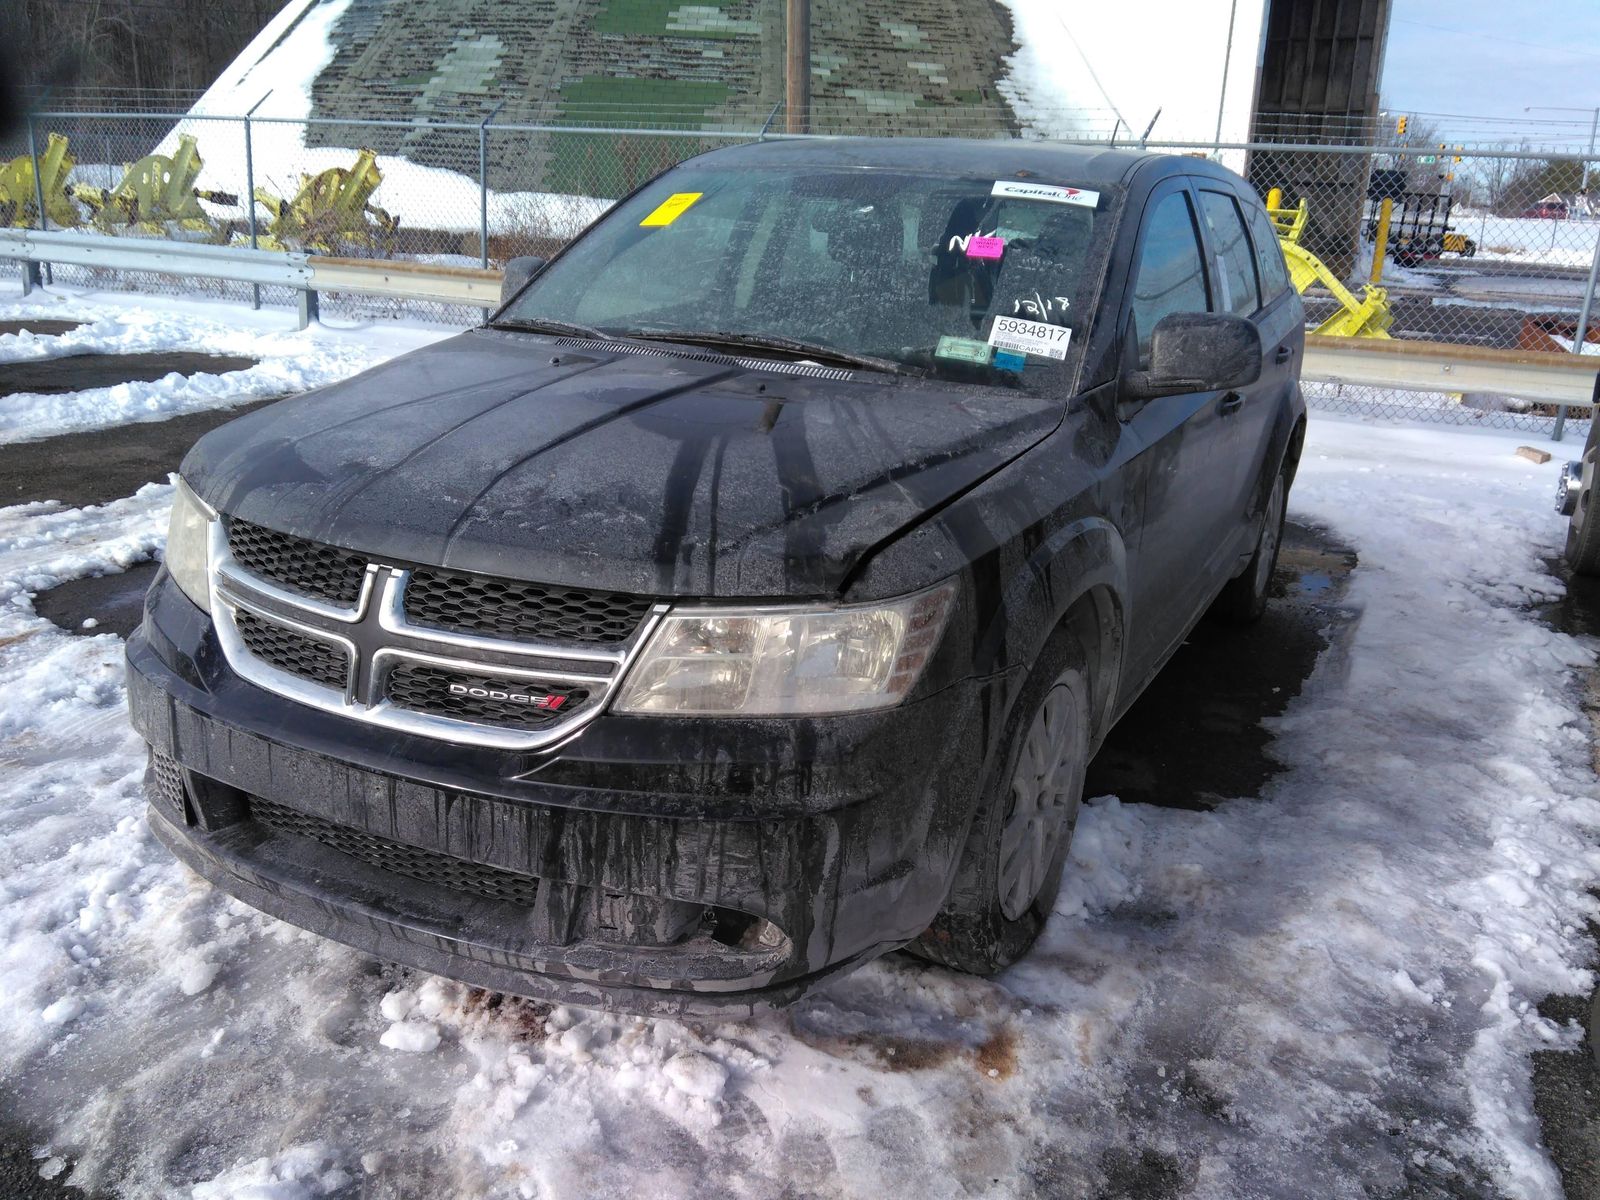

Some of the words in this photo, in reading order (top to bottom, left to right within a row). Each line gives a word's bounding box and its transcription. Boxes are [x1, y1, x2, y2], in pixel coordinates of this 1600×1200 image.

[997, 319, 1067, 342] 5934817
[1018, 343, 1044, 355] CAPO
[449, 683, 549, 705] DODGE
